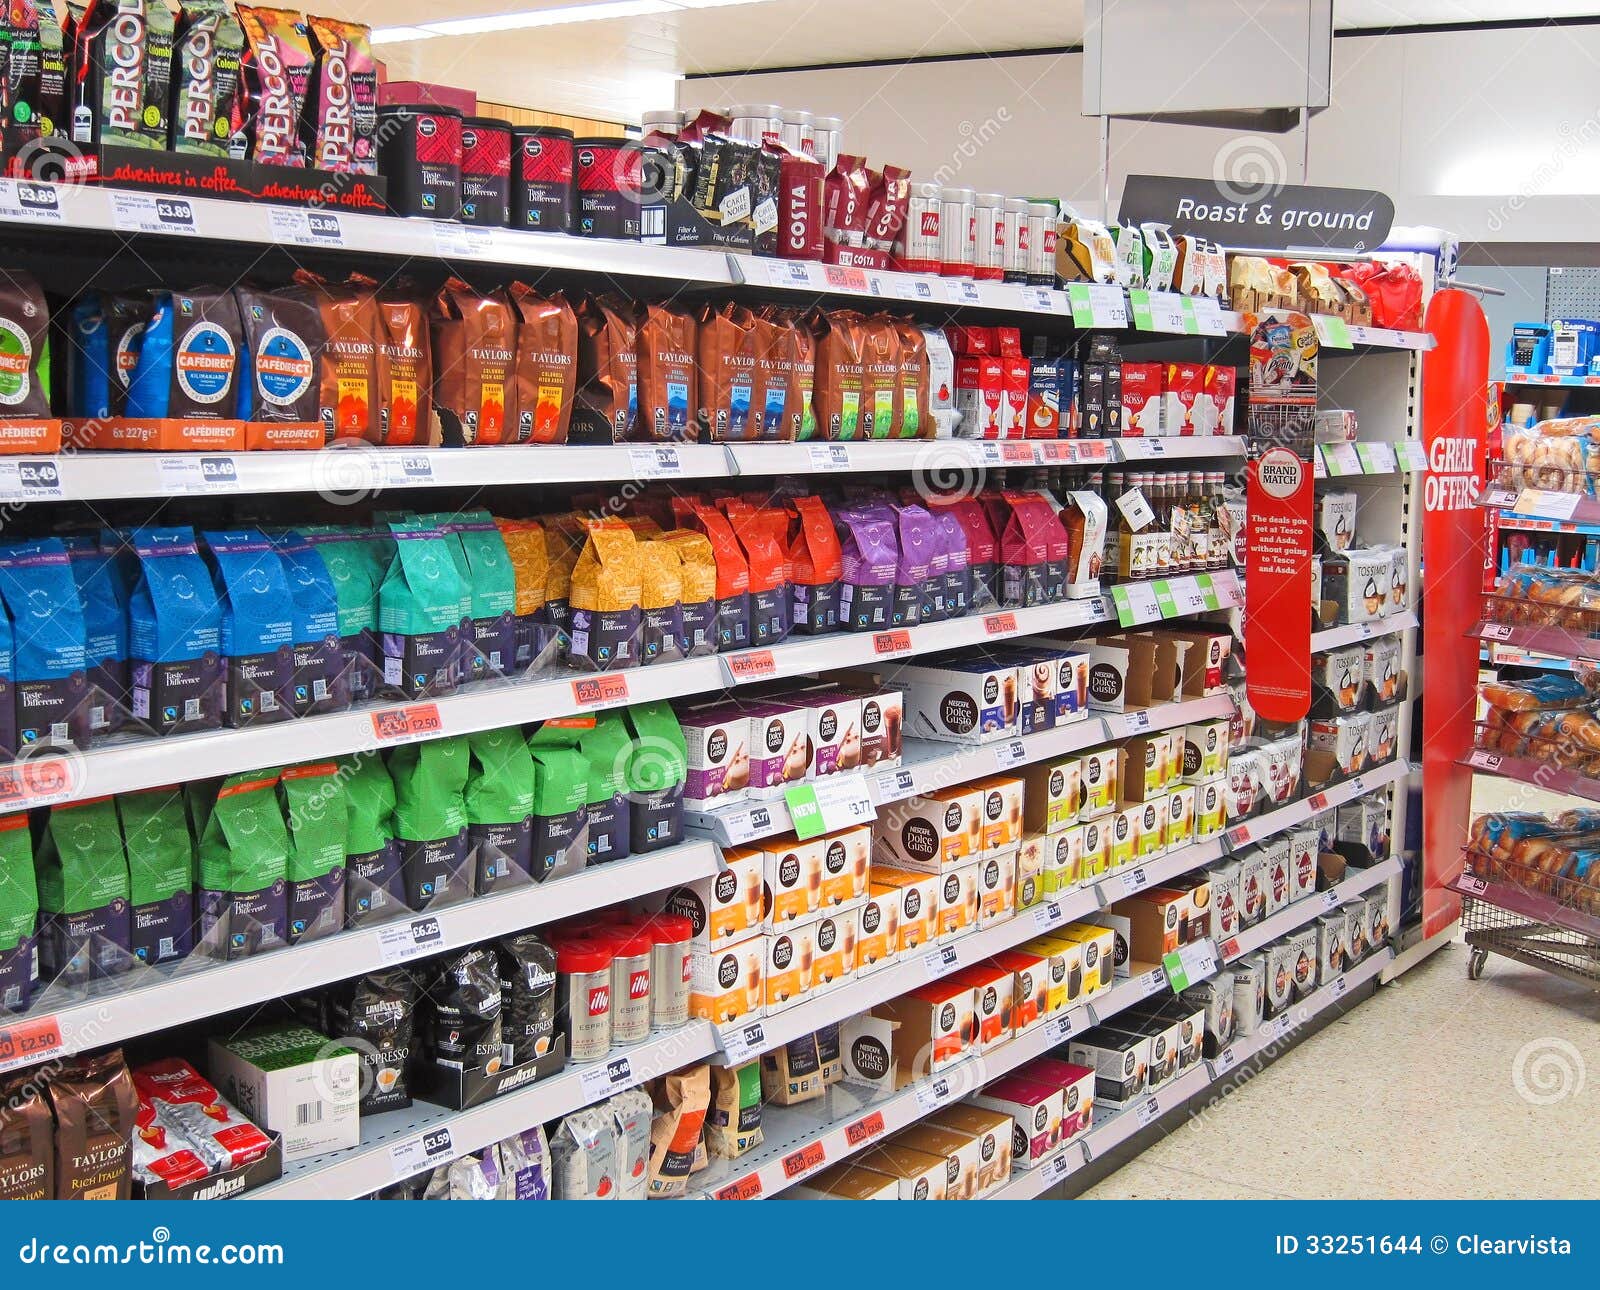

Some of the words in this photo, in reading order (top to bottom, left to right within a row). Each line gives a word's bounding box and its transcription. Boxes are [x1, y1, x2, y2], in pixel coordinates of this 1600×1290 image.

[110, 0, 144, 130] PERCOL
[184, 14, 220, 140] PERCOL
[261, 34, 289, 154] PERCOL
[321, 39, 349, 162] PERCOL
[113, 164, 182, 186] adventures
[185, 171, 197, 185] in
[201, 167, 240, 192] coffee
[422, 171, 441, 180] Taste
[423, 178, 455, 187] Difference
[18, 187, 57, 205] £3.89
[263, 184, 327, 200] adventures
[342, 184, 375, 207] coffee
[464, 188, 498, 197] Difference
[529, 195, 561, 204] Difference
[157, 202, 191, 219] £3.89
[876, 181, 897, 237] COSTA
[790, 185, 806, 250] COSTA
[1176, 198, 1248, 224] Roast
[1254, 205, 1273, 224] &
[1281, 207, 1374, 232] ground
[310, 218, 338, 233] £3.89
[923, 216, 939, 234] illy
[853, 255, 874, 267] COSTA
[325, 343, 374, 354] TAYLORS
[380, 345, 423, 358] TAYLORS
[472, 349, 512, 360] TAYLORS
[531, 353, 571, 365] TAYLORS
[658, 353, 693, 363] TAYLORS
[178, 355, 234, 369] CAFÉDIRECT
[256, 357, 311, 374] CAFÉDIRECT
[759, 360, 791, 370] TAYLORS
[868, 365, 897, 373] TAYLORS
[1123, 394, 1143, 405] ROSSA
[351, 414, 358, 426] 3
[402, 415, 407, 426] 3
[489, 416, 495, 428] 3
[676, 413, 681, 422] 4
[736, 416, 741, 424] 4
[771, 418, 776, 426] 4
[544, 419, 550, 429] 3
[183, 426, 235, 438] CAFÉDIRECT
[266, 428, 319, 439] CAFÉDIRECT
[1429, 437, 1477, 473] GREAT
[202, 464, 234, 476] £3.49
[404, 459, 429, 470] £3.89
[21, 466, 56, 481] £3.49
[1263, 465, 1297, 476] BRAND
[1263, 475, 1297, 485] MATCH
[1424, 475, 1480, 512] OFFERS
[1251, 515, 1268, 523] The
[1294, 518, 1307, 526] you
[1255, 526, 1267, 534] get
[1269, 526, 1279, 534] at
[1281, 527, 1303, 535] Tesco
[1276, 536, 1298, 545] Asda,
[1251, 545, 1285, 554] without
[1288, 547, 1307, 556] going
[1262, 556, 1270, 564] to
[1272, 556, 1295, 564] Tesco
[1259, 566, 1273, 574] and
[1276, 566, 1298, 575] Asda.
[1358, 565, 1387, 577] TOSSIMO
[895, 640, 910, 649] £2.50
[241, 664, 259, 672] Taste
[242, 670, 275, 679] Difference
[1095, 672, 1115, 680] NESCAFÉ
[166, 677, 201, 686] Difference
[1093, 678, 1117, 687] Dolce
[21, 691, 43, 699] Taste
[605, 687, 626, 698] £2.50
[1095, 685, 1117, 695] Gusto
[23, 697, 64, 707] Difference
[948, 699, 970, 708] NESCAFÉ
[946, 705, 973, 717] Dolce
[413, 718, 438, 729] £2.50
[946, 714, 971, 726] Gusto
[821, 722, 837, 730] Dolce
[822, 728, 836, 736] Gusto
[709, 741, 727, 751] Dolce
[711, 748, 725, 757] Gusto
[793, 803, 817, 817] NEW
[849, 800, 870, 816] £3.77
[750, 811, 769, 824] £3.77
[752, 812, 770, 823] £3.77
[909, 826, 931, 836] NESCAFÉ
[907, 833, 933, 845] Dolce
[907, 841, 933, 854] Gusto
[296, 889, 313, 897] Taste
[296, 892, 327, 902] Difference
[233, 900, 254, 909] Taste
[235, 904, 268, 915] Difference
[412, 922, 439, 938] £6.25
[631, 974, 649, 995] illy
[590, 991, 609, 1012] illy
[745, 1027, 764, 1042] £3.77
[21, 1033, 55, 1051] £2.50
[859, 1046, 881, 1055] NESCAFÉ
[364, 1047, 409, 1066] ESPRESSO
[857, 1053, 884, 1065] Dolce
[609, 1063, 629, 1077] £6.48
[857, 1061, 883, 1072] Gusto
[498, 1066, 537, 1085] LAVAZZA
[424, 1134, 450, 1152] £3.59
[806, 1152, 824, 1166] £2.50
[72, 1177, 95, 1190] RICH
[192, 1176, 247, 1200] LAVAZZA
